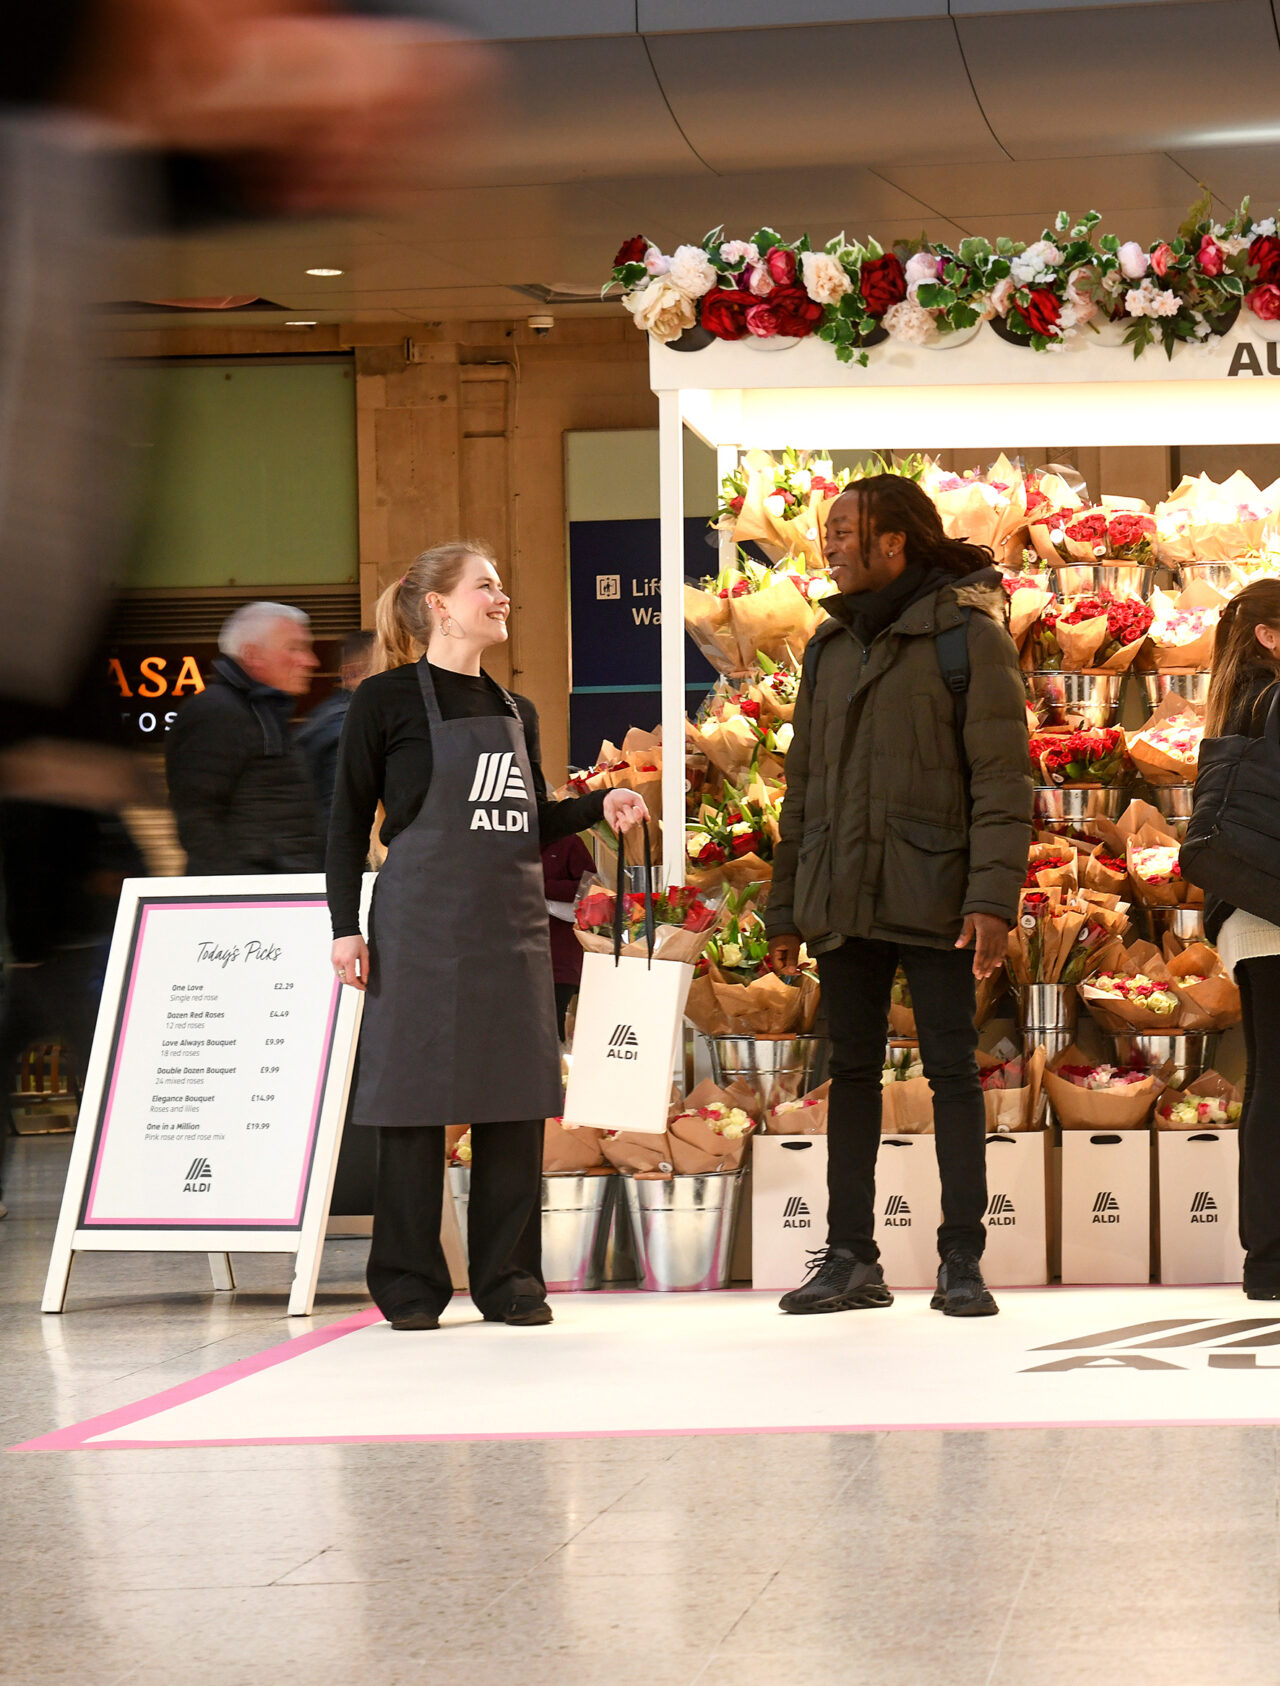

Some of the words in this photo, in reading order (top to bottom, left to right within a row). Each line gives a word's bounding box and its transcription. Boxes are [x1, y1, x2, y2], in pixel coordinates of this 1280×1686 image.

[470, 809, 529, 833] ALDI
[197, 941, 240, 969] Today's
[244, 940, 282, 963] Picks
[170, 995, 191, 1003] Single
[180, 1039, 205, 1047] Always
[607, 1049, 638, 1060] ALDI
[206, 1067, 237, 1075] Bouquet
[152, 1095, 183, 1103] Elegance
[183, 1183, 211, 1192] ALDI
[885, 1219, 912, 1227] ALDI
[988, 1217, 1015, 1226] ALDI
[1092, 1215, 1120, 1223] ALDI
[1190, 1215, 1218, 1223] ALDI
[783, 1220, 811, 1228] ALDI
